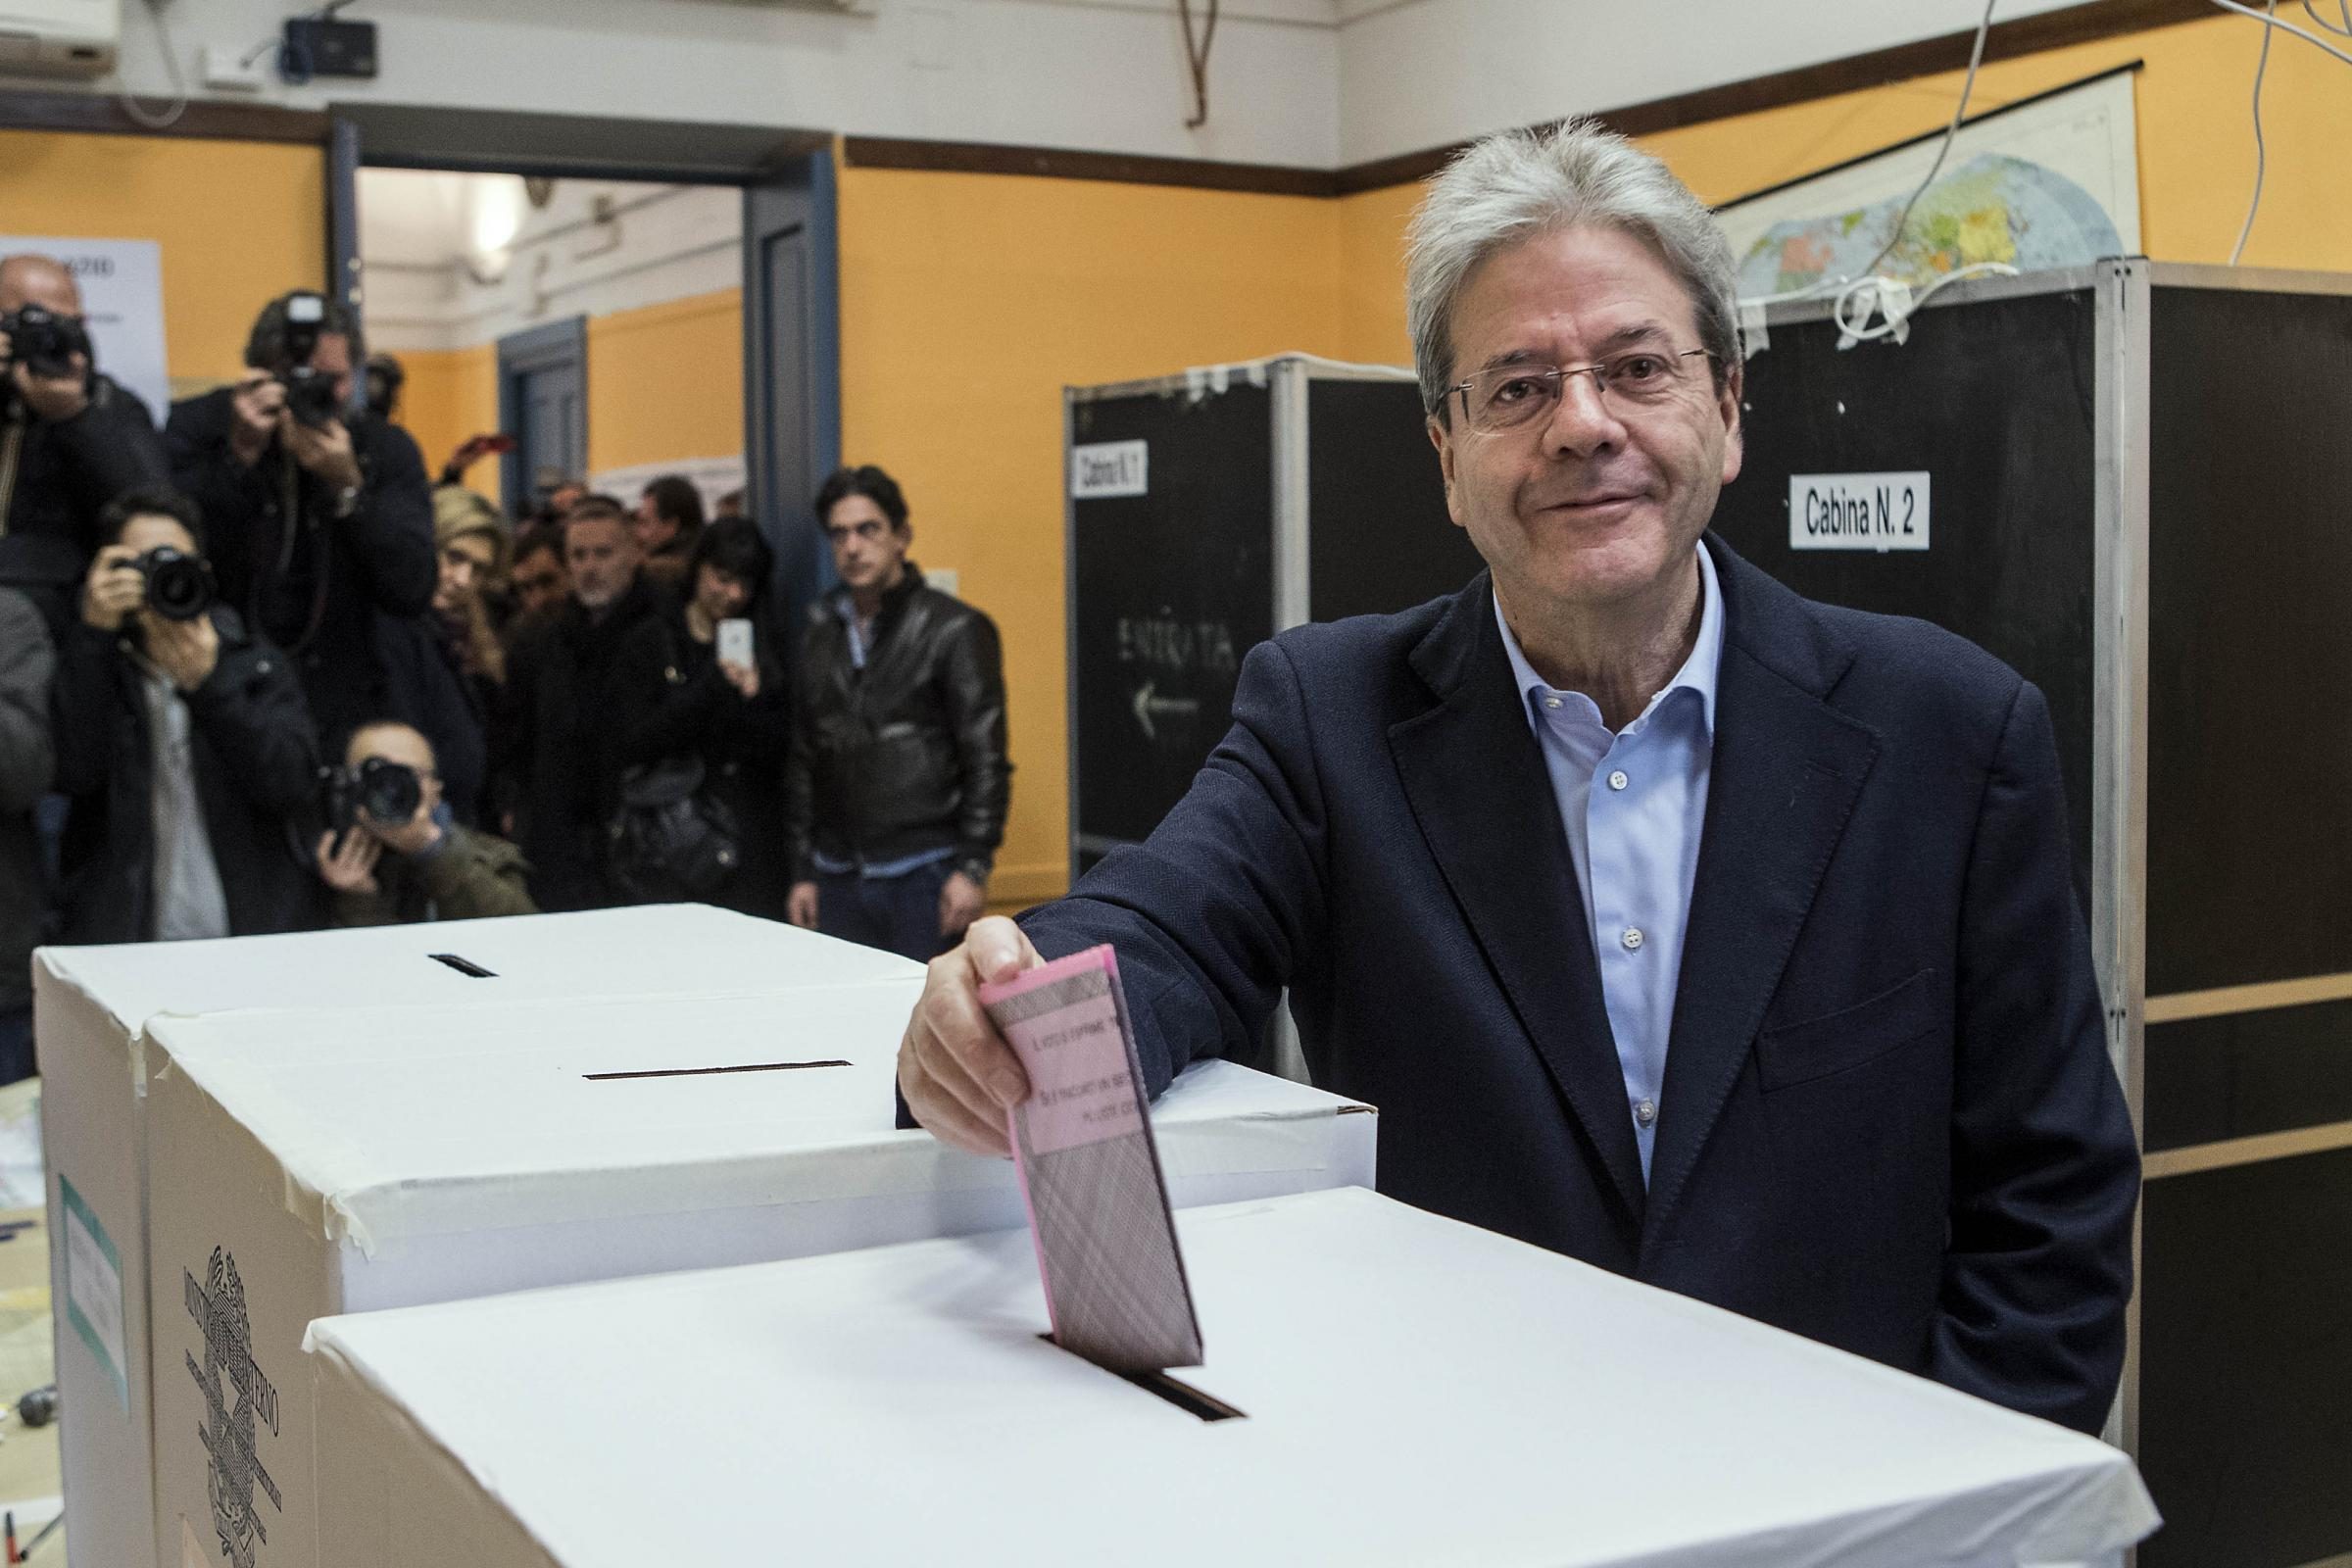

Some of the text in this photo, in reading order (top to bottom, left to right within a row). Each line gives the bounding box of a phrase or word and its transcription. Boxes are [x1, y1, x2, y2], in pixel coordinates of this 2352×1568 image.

[1806, 486, 1914, 536] Cabina N. 2
